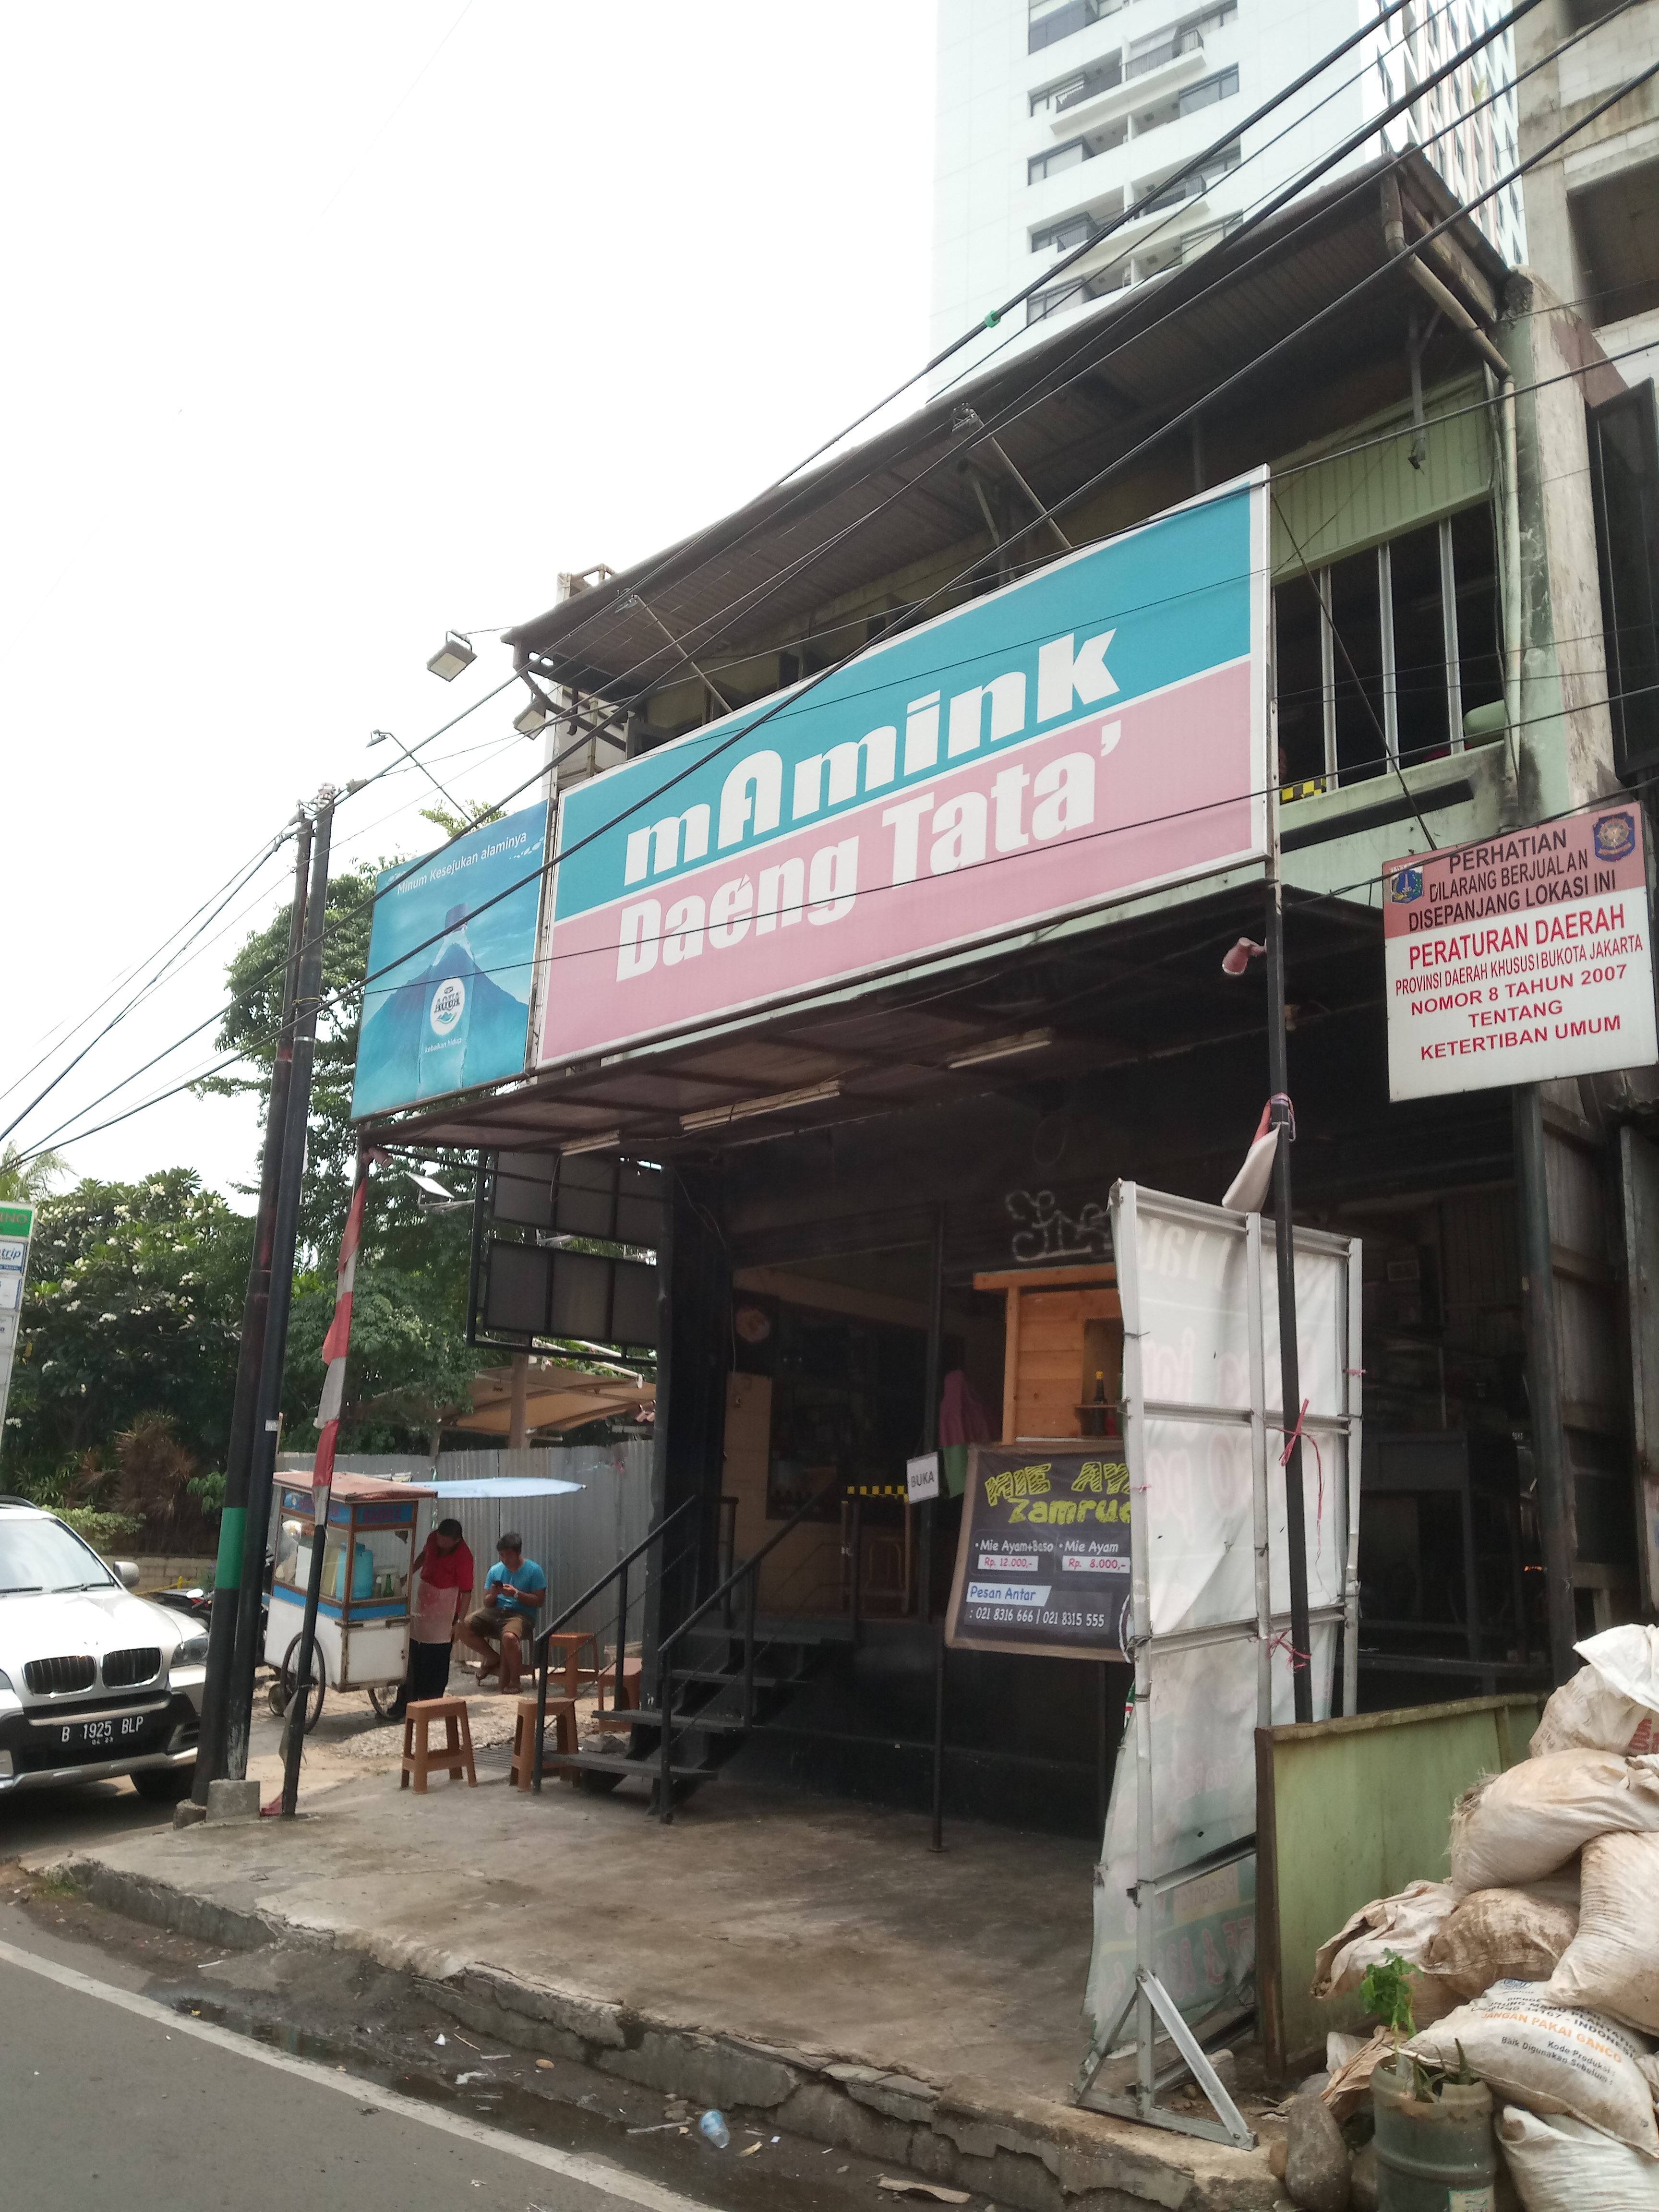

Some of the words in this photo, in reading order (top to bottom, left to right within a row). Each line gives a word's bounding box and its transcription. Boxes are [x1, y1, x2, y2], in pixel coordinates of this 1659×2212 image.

[397, 874, 427, 895] Minum
[430, 853, 478, 882] Kesejukan
[481, 832, 527, 860] alaminya
[1449, 828, 1567, 874] PERHATIAN
[1430, 870, 1497, 903] DILARANG
[1502, 848, 1588, 887] BERJUALAN
[1409, 890, 1520, 932] DISEPANJANG
[1526, 875, 1588, 907] LOKASI
[1594, 869, 1616, 893] INI
[1409, 923, 1528, 970] PERATURAN
[1536, 903, 1625, 945] DAERAH
[1395, 972, 1442, 996] PROVINSI
[1445, 962, 1488, 987] DAERAH
[1491, 954, 1534, 978] KHUSUS
[1589, 934, 1643, 960] JAKARTA
[434, 993, 460, 1013] AQUA
[1411, 990, 1482, 1016] NOMOR
[1489, 986, 1499, 1002] 8
[1504, 973, 1574, 998] TAHUN
[1580, 963, 1627, 985] 2007
[1468, 999, 1563, 1028] TENTANG
[424, 1041, 446, 1053] kebaikan
[447, 1037, 462, 1046] hidup
[1420, 1026, 1548, 1060] KETERTIBAN
[1555, 1015, 1621, 1039] UMUM
[911, 1471, 935, 1488] BUKA
[985, 1463, 1052, 1506] MIE
[980, 1539, 998, 1551] Mie
[1064, 1540, 1085, 1552] Mie
[1088, 1541, 1119, 1555] Ayam
[985, 1557, 996, 1569] Rp.
[1069, 1558, 1081, 1571] Rp.
[1089, 1559, 1126, 1571] 8.000,-
[970, 1585, 1001, 1599] Pesan
[1005, 1587, 1036, 1601] Antar
[975, 1607, 990, 1620] 021
[993, 1608, 1013, 1622] 8316
[1016, 1609, 1033, 1623] 666
[1043, 1611, 1058, 1624] 021
[1062, 1612, 1082, 1626] 8315
[1085, 1613, 1105, 1628] 555
[61, 1726, 70, 1743] B
[83, 1720, 112, 1740] 1925
[121, 1716, 144, 1734] BLP
[1532, 2017, 1572, 2037] PAKAI
[1502, 2036, 1519, 2048] Baik
[1522, 2042, 1568, 2065] Digunakan
[1547, 2040, 1570, 2055] Kode
